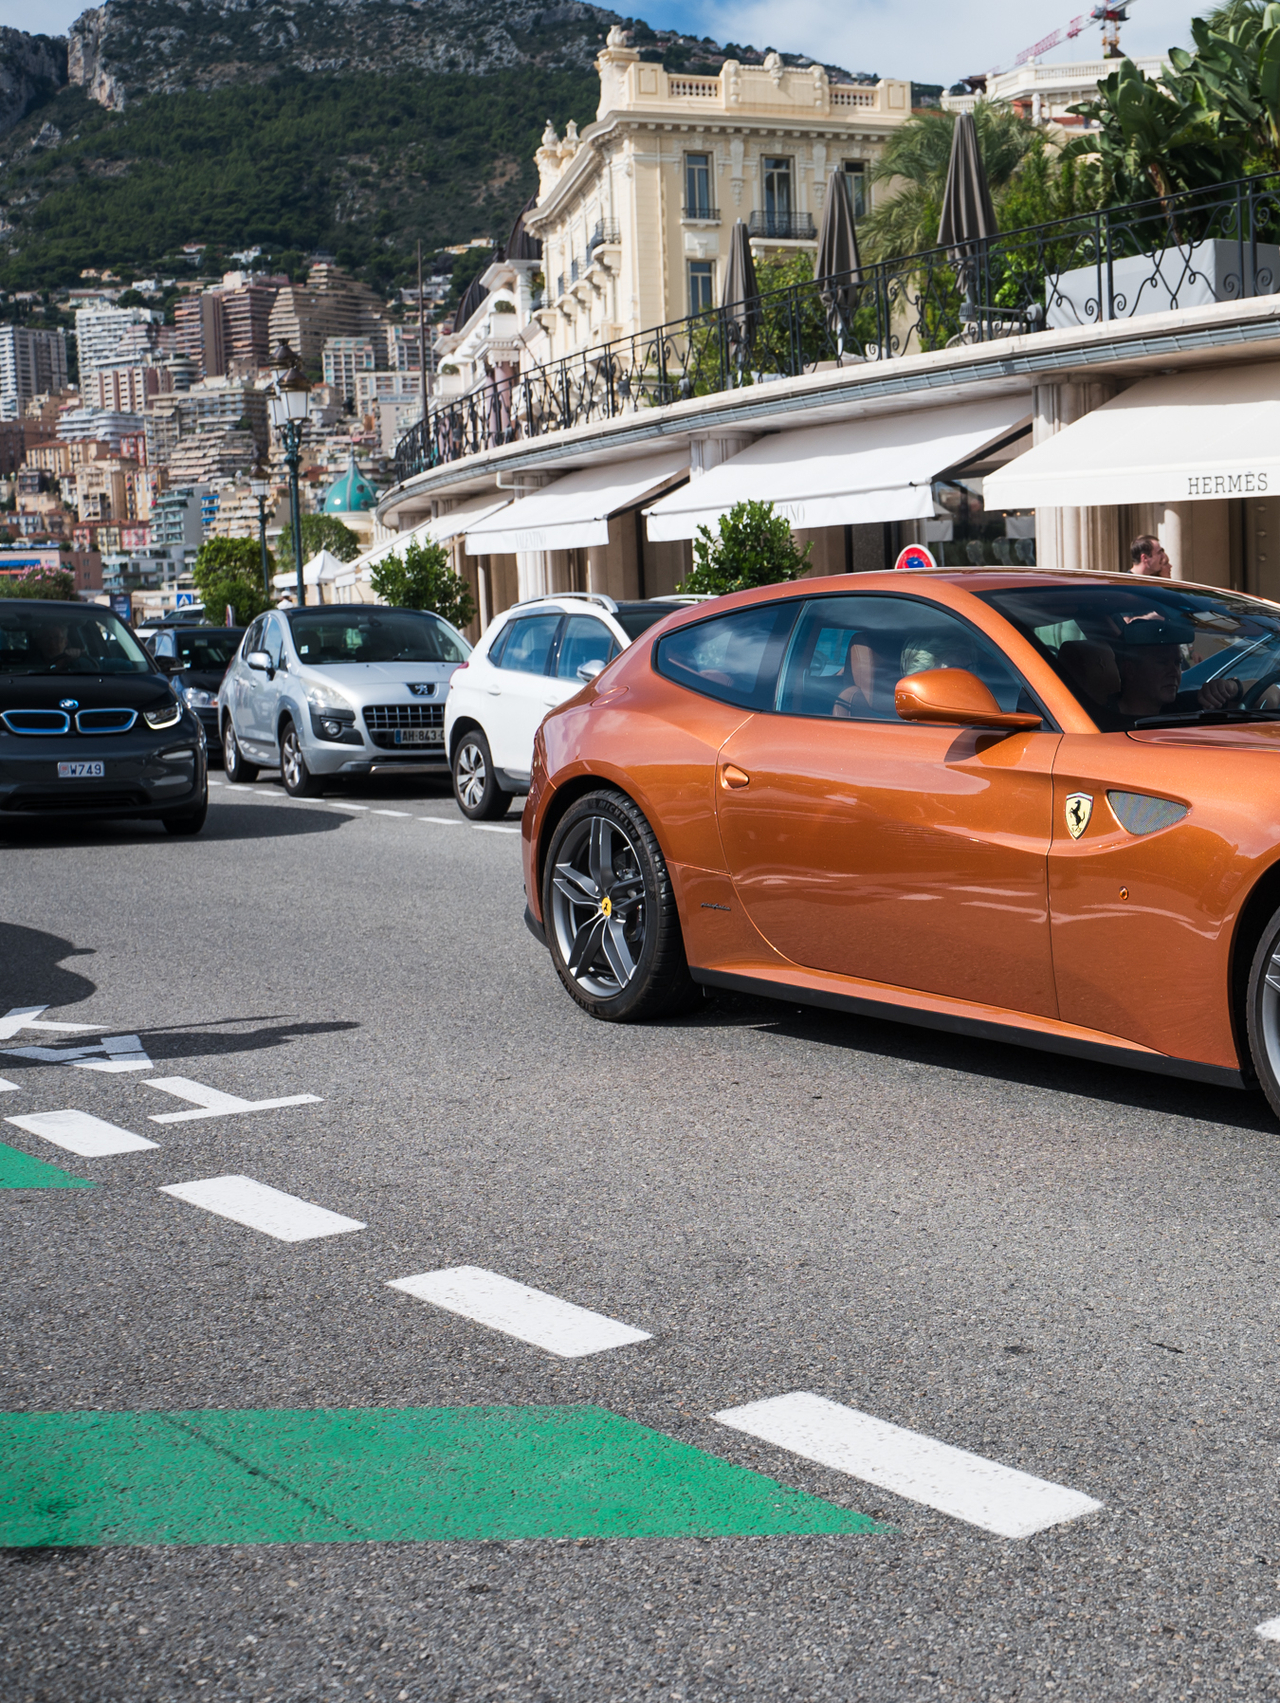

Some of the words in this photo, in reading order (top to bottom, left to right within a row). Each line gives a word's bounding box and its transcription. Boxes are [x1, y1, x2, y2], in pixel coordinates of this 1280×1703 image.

[1187, 471, 1268, 495] HERMÈS
[70, 764, 102, 775] W749
[597, 799, 639, 840] MICHELIN
